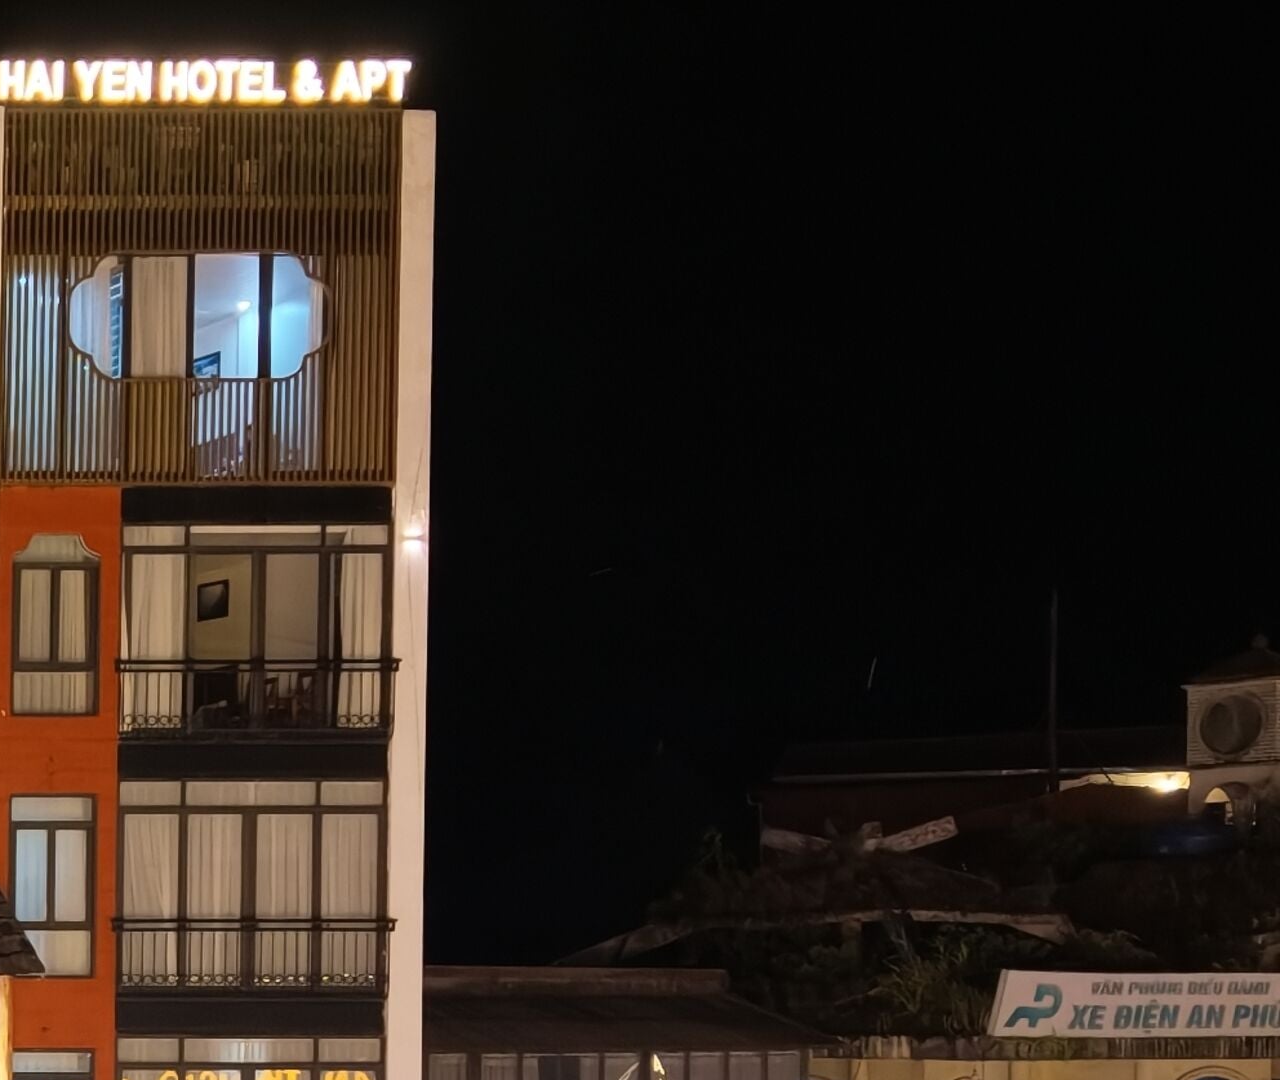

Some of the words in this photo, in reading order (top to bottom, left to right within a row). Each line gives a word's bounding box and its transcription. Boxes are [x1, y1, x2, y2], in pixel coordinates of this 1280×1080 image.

[74, 59, 153, 101] YEN
[160, 59, 286, 101] HOTEL
[294, 59, 324, 101] &
[332, 59, 412, 101] APT
[1068, 1003, 1106, 1029] XE
[1113, 1000, 1179, 1033] ĐIỆN
[1185, 1004, 1228, 1029] AN
